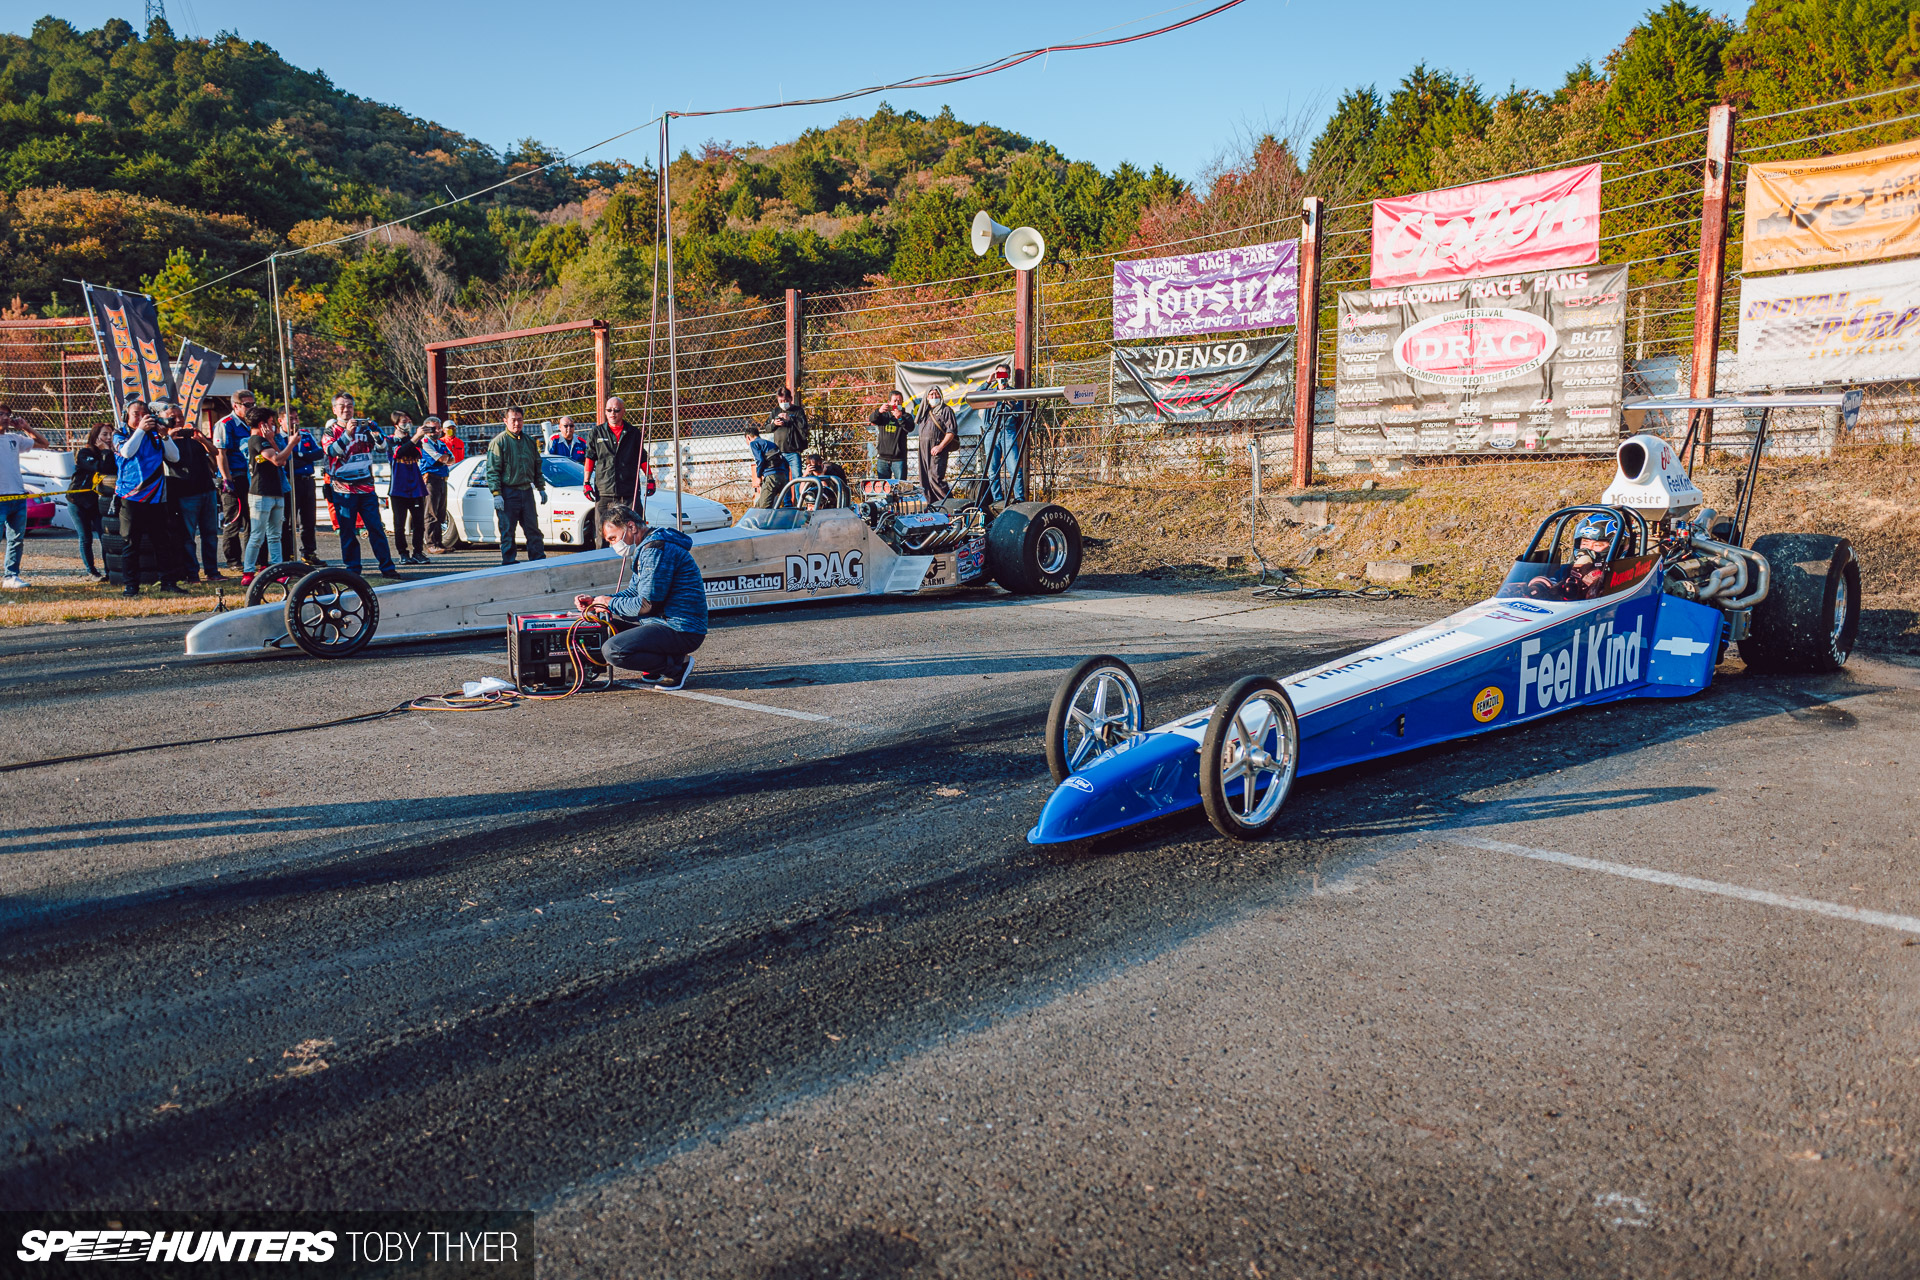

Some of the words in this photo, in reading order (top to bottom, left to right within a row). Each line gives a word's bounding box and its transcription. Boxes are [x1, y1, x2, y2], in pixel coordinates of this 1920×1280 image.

[1790, 168, 1804, 176] LSD
[1809, 164, 1842, 173] CARBON
[1845, 158, 1878, 169] CLUTCH
[1884, 153, 1906, 162] FULL
[1382, 191, 1587, 278] Option
[1133, 260, 1188, 277] WELCOME
[1198, 253, 1232, 272] RACE
[1242, 248, 1277, 266] FANS
[1124, 267, 1286, 330] Hoosier
[1370, 285, 1460, 308] WELCOME
[1471, 279, 1522, 299] RACE
[1534, 272, 1589, 293] FANS
[1443, 312, 1466, 322] DRAG
[1466, 308, 1504, 319] FESTIVAL
[1744, 291, 1850, 321] ROYAL
[1171, 312, 1233, 333] RACING
[1342, 311, 1389, 331] Option
[1461, 322, 1485, 332] JAPAN
[1342, 330, 1389, 347] Hoosier
[1415, 331, 1533, 361] DRAG
[1570, 329, 1613, 345] BLITZ
[103, 303, 147, 403] FESTI
[1155, 342, 1248, 372] DENSO
[1341, 352, 1386, 363] TRUST
[1578, 345, 1618, 358] TOMEI
[1808, 341, 1908, 360] SYNTHETIC
[136, 336, 170, 403] DRA
[1347, 365, 1376, 377] HKS
[1406, 366, 1449, 384] CHAMPION
[1448, 376, 1467, 385] SHIP
[1468, 375, 1487, 385] FOR
[1487, 372, 1502, 382] THE
[1504, 358, 1541, 379] FASTEST
[1562, 363, 1618, 376] DENSO
[1562, 378, 1588, 387] AUTO
[1588, 376, 1618, 385] STAFF
[1584, 441, 1616, 450] Steelworks
[1611, 492, 1662, 505] Hoosier
[785, 549, 864, 593] DRAG
[831, 572, 864, 589] Racing
[703, 577, 736, 593] uzou
[738, 573, 782, 590] Racing
[921, 577, 946, 587] S.ARMY
[1517, 628, 1581, 715] Feel
[1584, 614, 1643, 695] Kind
